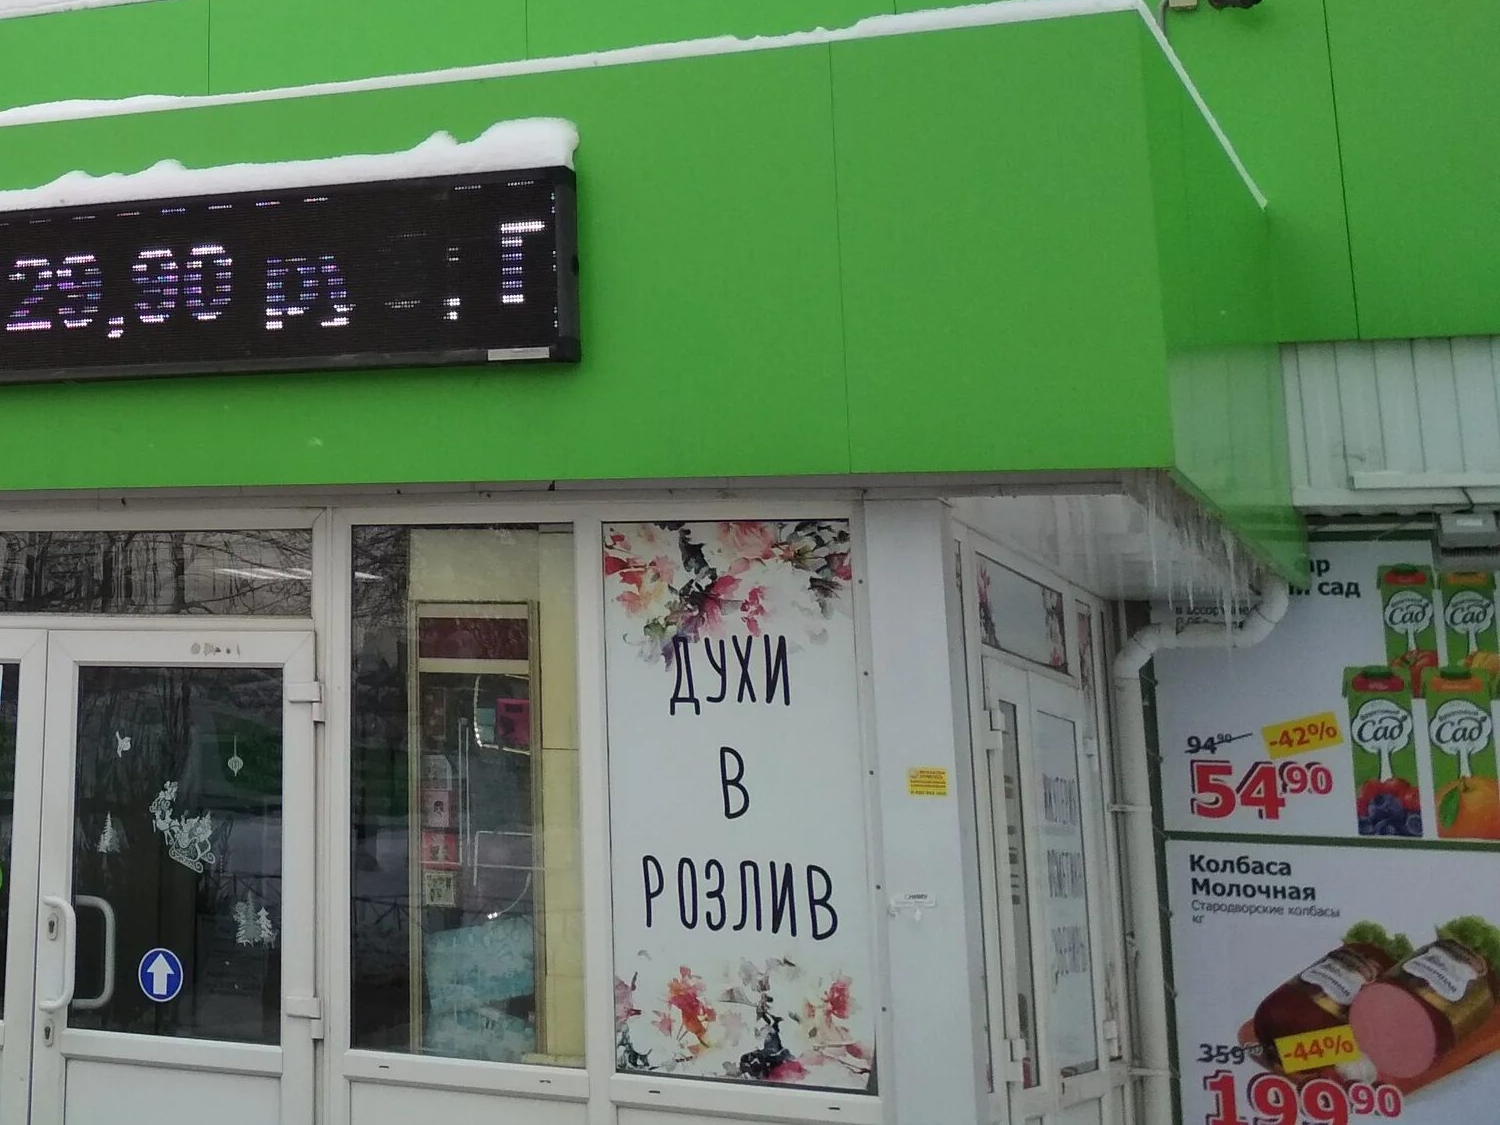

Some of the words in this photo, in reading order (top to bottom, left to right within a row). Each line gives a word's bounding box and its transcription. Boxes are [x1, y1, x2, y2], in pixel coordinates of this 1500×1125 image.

[1316, 580, 1361, 598] сад
[1388, 601, 1431, 626] Сад
[1449, 601, 1492, 626] Сад
[670, 634, 790, 716] ДУХИ
[1269, 721, 1339, 748] -42%
[1357, 714, 1409, 744] Сад
[1435, 716, 1488, 745] Сад
[719, 746, 750, 819] В
[1189, 853, 1292, 877] Колбаса
[642, 854, 838, 940] РОЗЛИВ
[1190, 877, 1316, 901] Молочная
[1190, 899, 1285, 914] Стародворские
[1287, 906, 1341, 918] колбасы
[1192, 914, 1205, 924] кг
[1283, 1034, 1355, 1062] -44%
